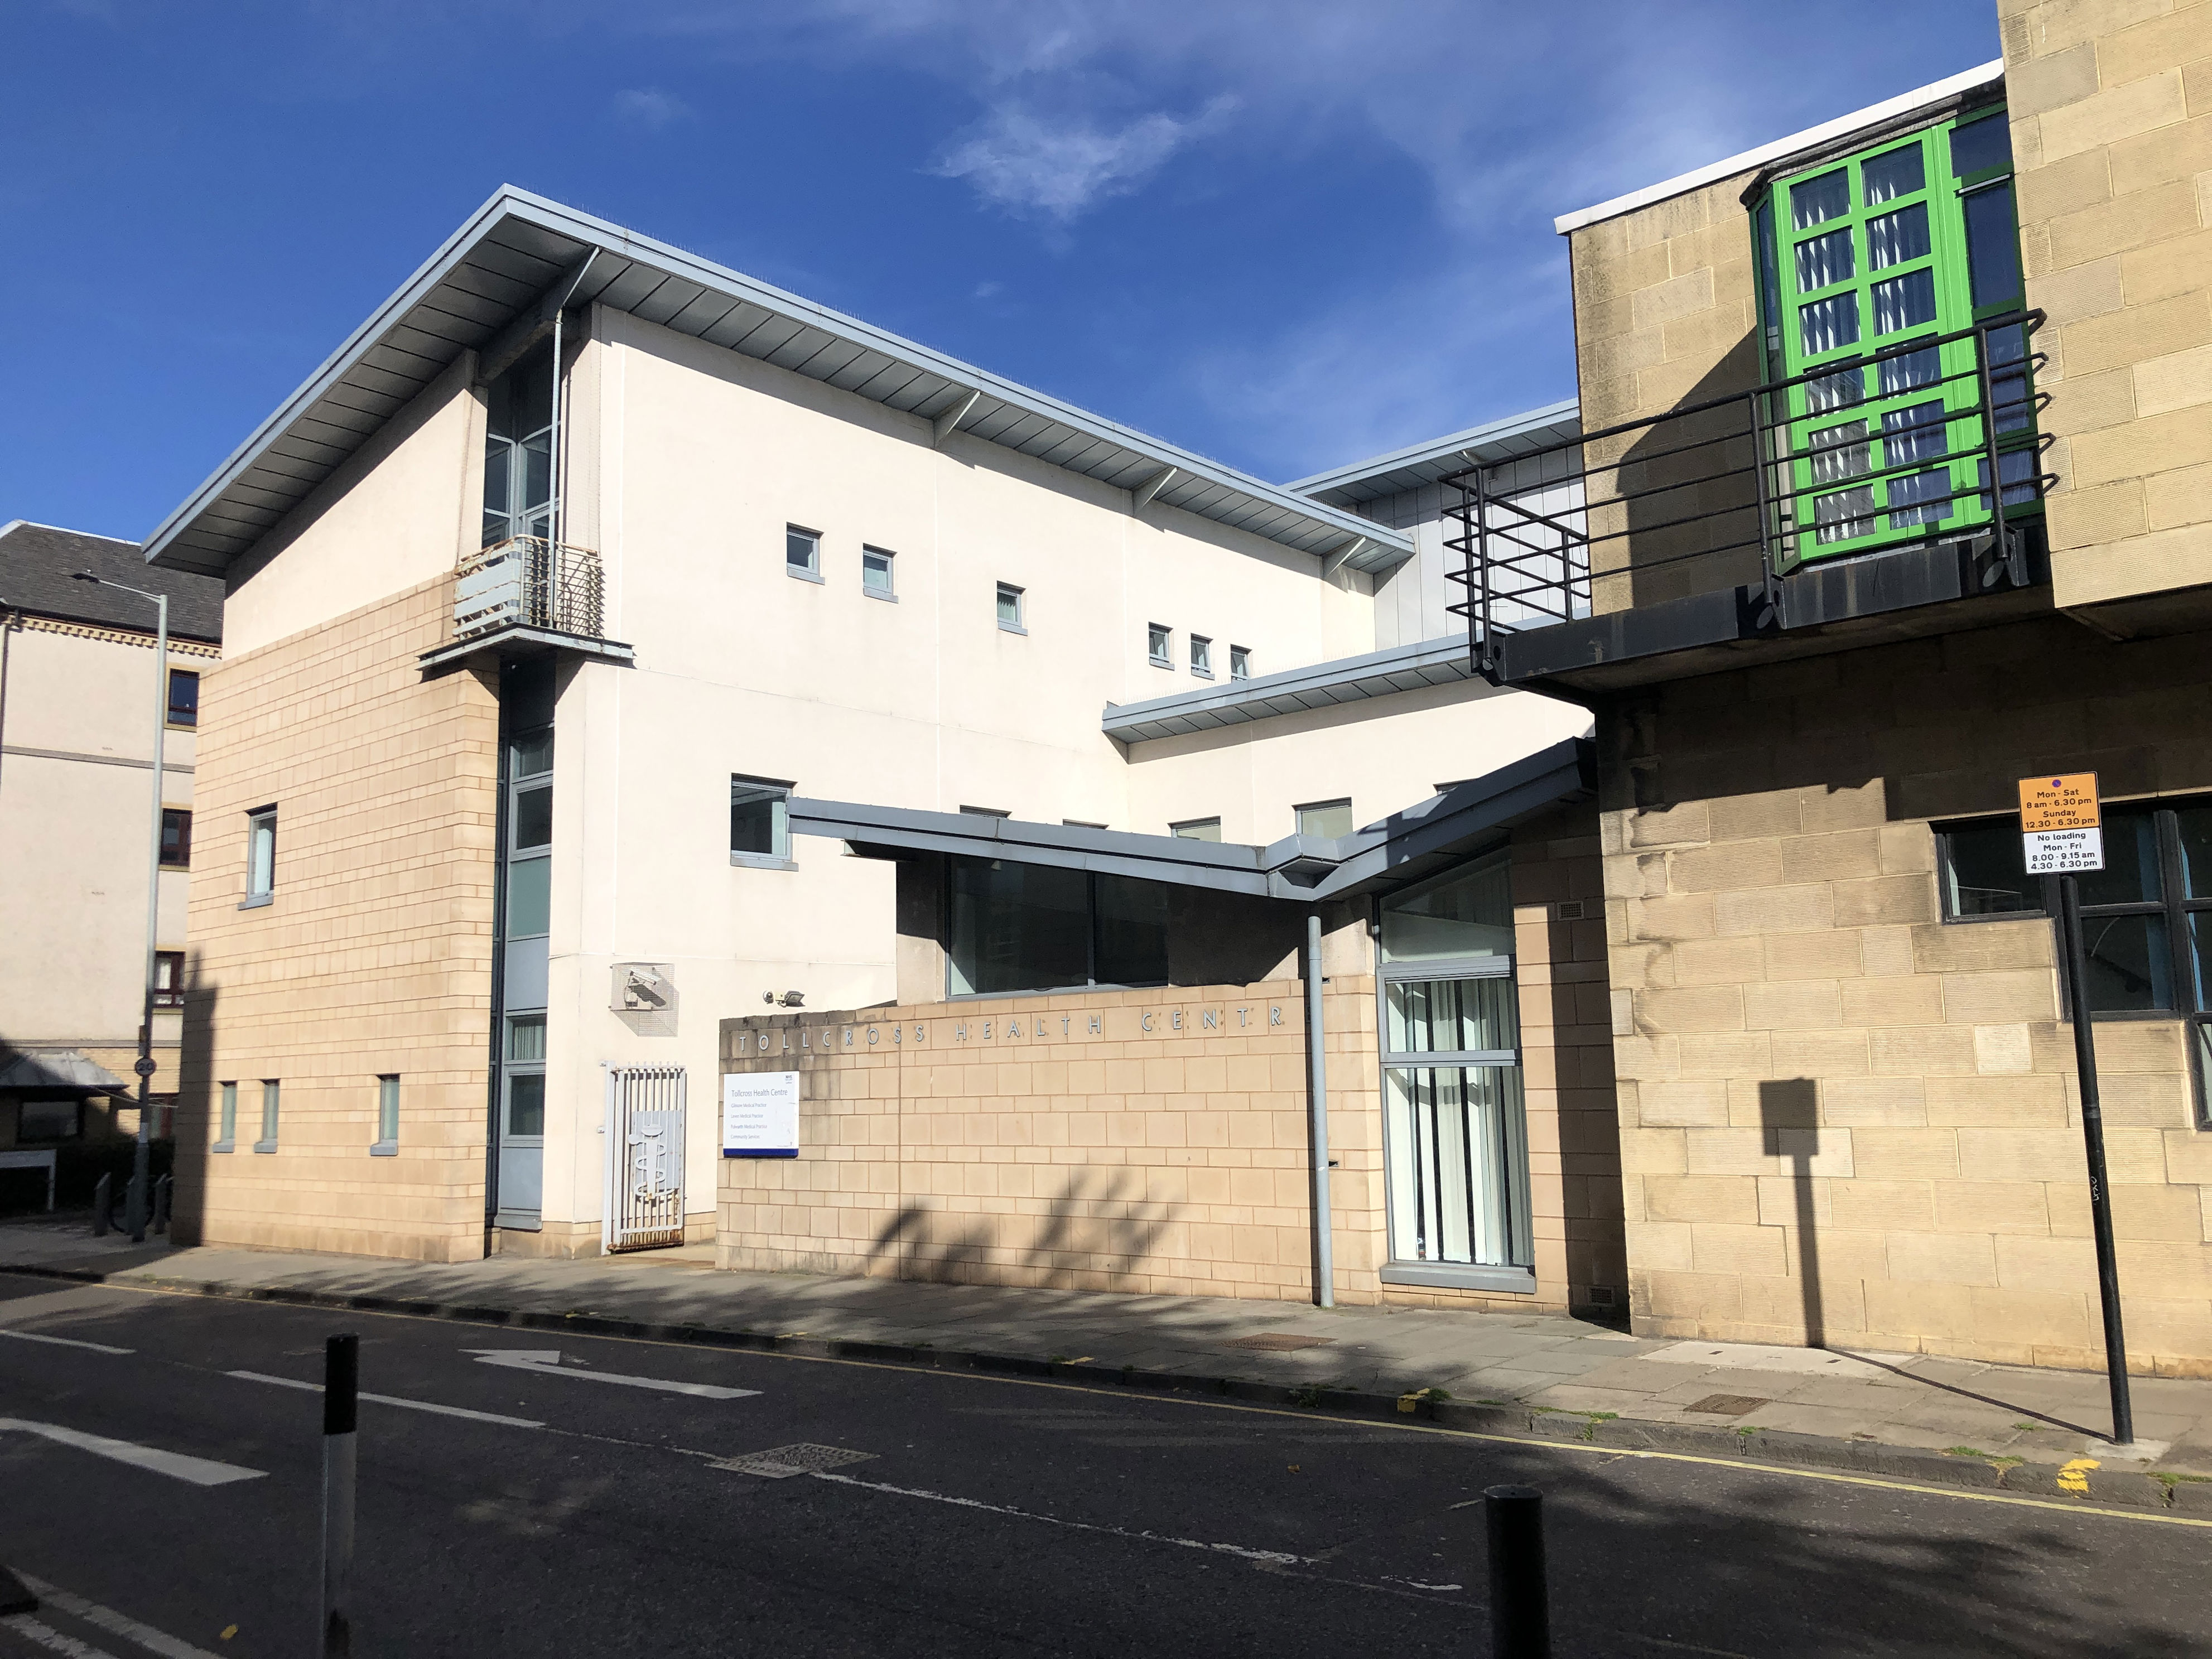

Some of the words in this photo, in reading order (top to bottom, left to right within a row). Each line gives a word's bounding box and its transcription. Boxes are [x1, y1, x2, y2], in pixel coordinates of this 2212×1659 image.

[2026, 820, 2050, 828] 12.30
[739, 1024, 924, 1052] TOLLCROSS
[955, 1015, 1101, 1041] HEALTH
[138, 1062, 154, 1071] 20
